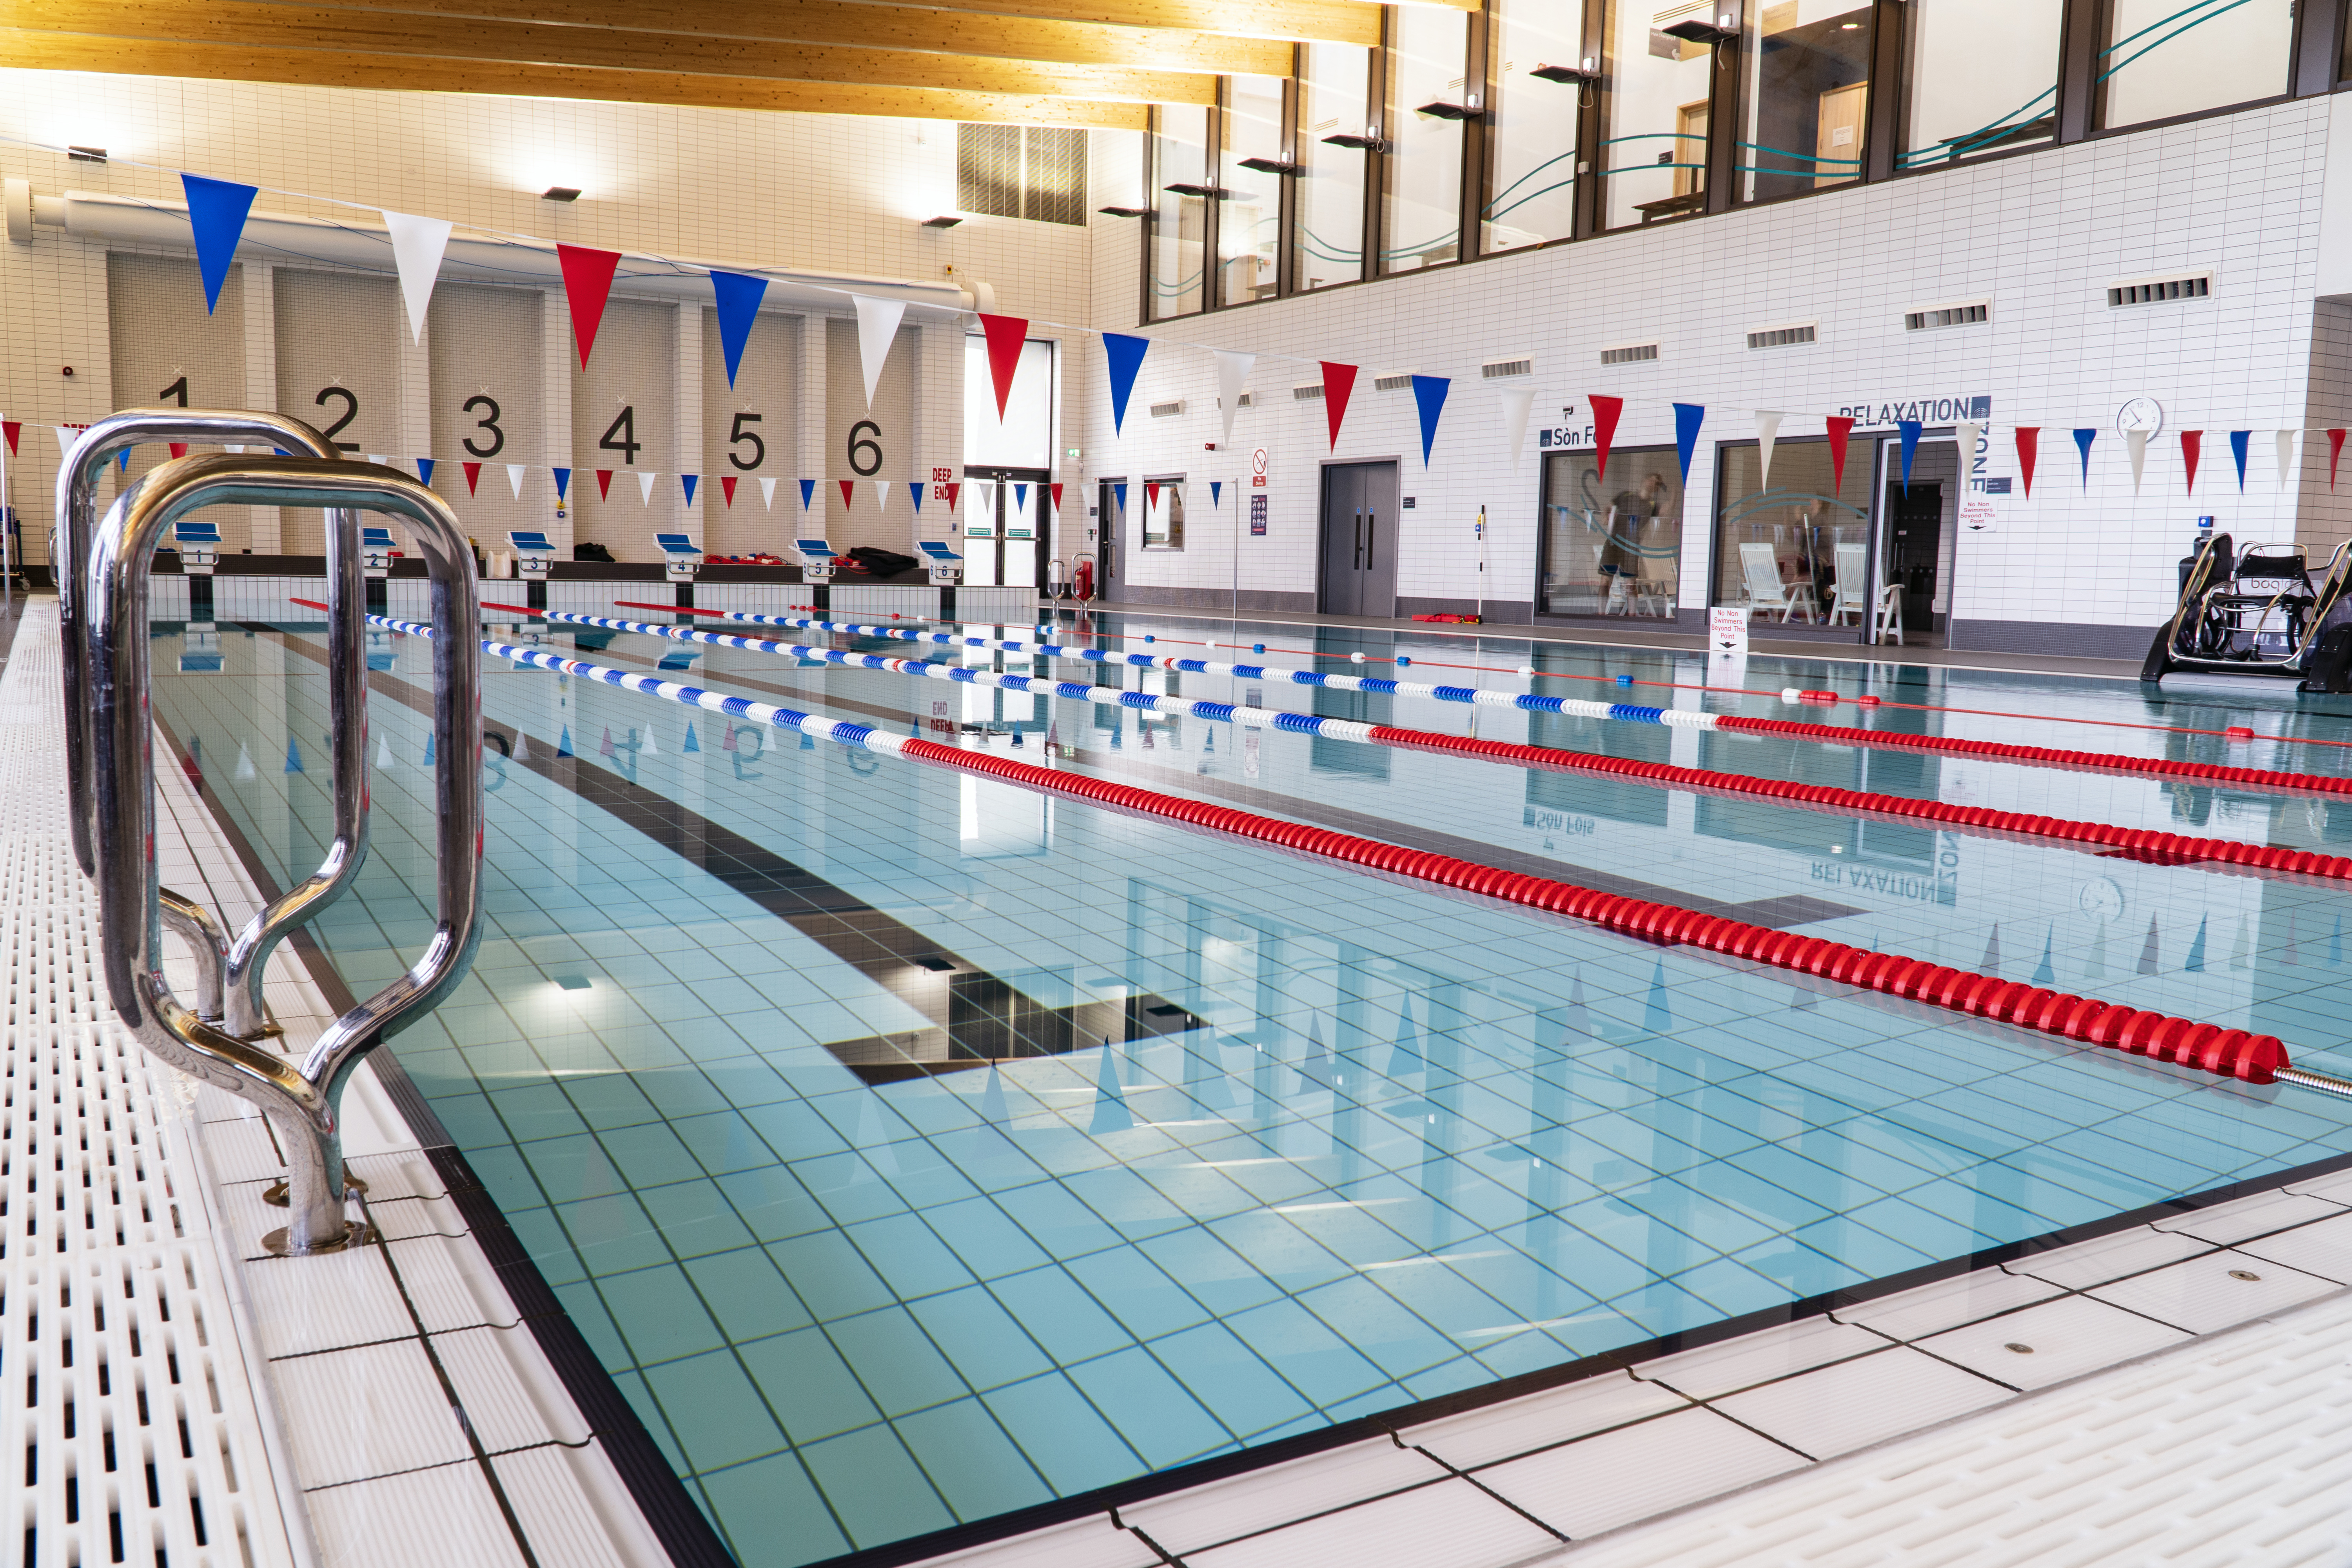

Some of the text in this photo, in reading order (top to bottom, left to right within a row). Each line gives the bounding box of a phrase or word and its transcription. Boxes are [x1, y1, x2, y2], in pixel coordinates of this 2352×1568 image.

[1659, 33, 1673, 41] Changing
[160, 377, 188, 407] 1
[316, 387, 360, 452] 2
[463, 396, 505, 458] 3
[599, 406, 641, 465] 4
[729, 413, 765, 470] 5
[1553, 427, 1579, 446] Sòn
[848, 421, 883, 476] 6
[933, 468, 951, 482] DEEP
[935, 486, 949, 500] END
[370, 554, 378, 566] 2
[531, 557, 538, 569] 3
[678, 560, 685, 571] 4
[815, 563, 821, 574] 5
[930, 565, 933, 576] 6
